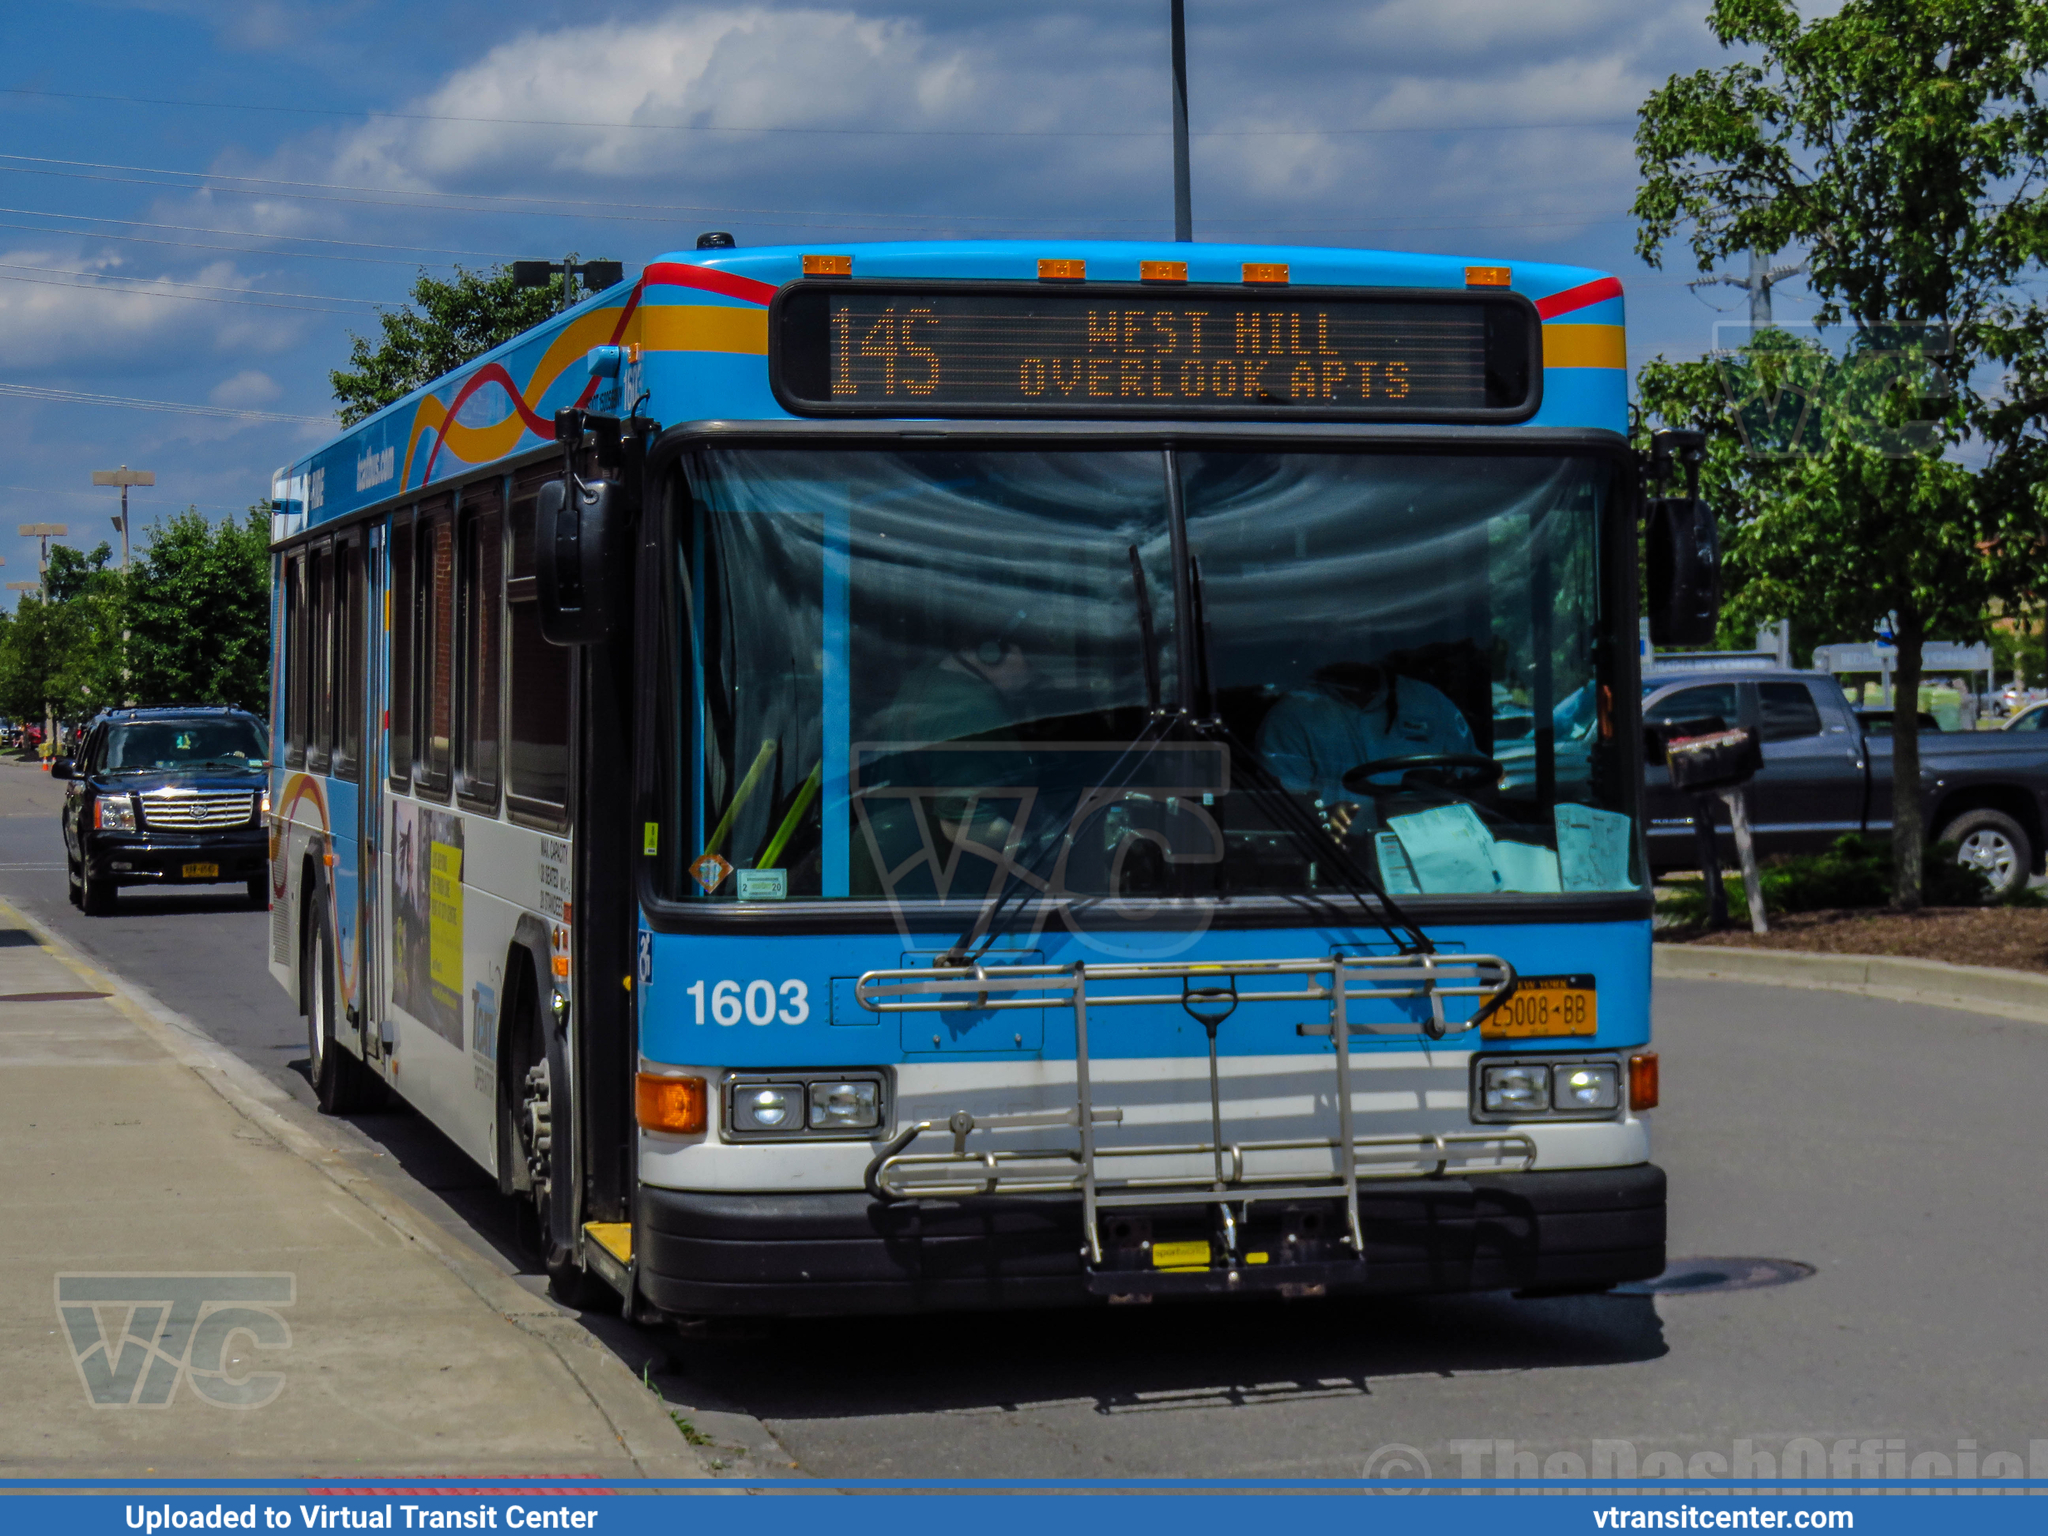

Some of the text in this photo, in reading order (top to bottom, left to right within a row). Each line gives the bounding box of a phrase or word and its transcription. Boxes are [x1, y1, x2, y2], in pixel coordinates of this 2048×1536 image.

[1088, 311, 1339, 355] WEST HILL
[1020, 359, 1409, 398] OVERLOOK APTS
[772, 883, 782, 892] 20
[686, 978, 810, 1026] 1603
